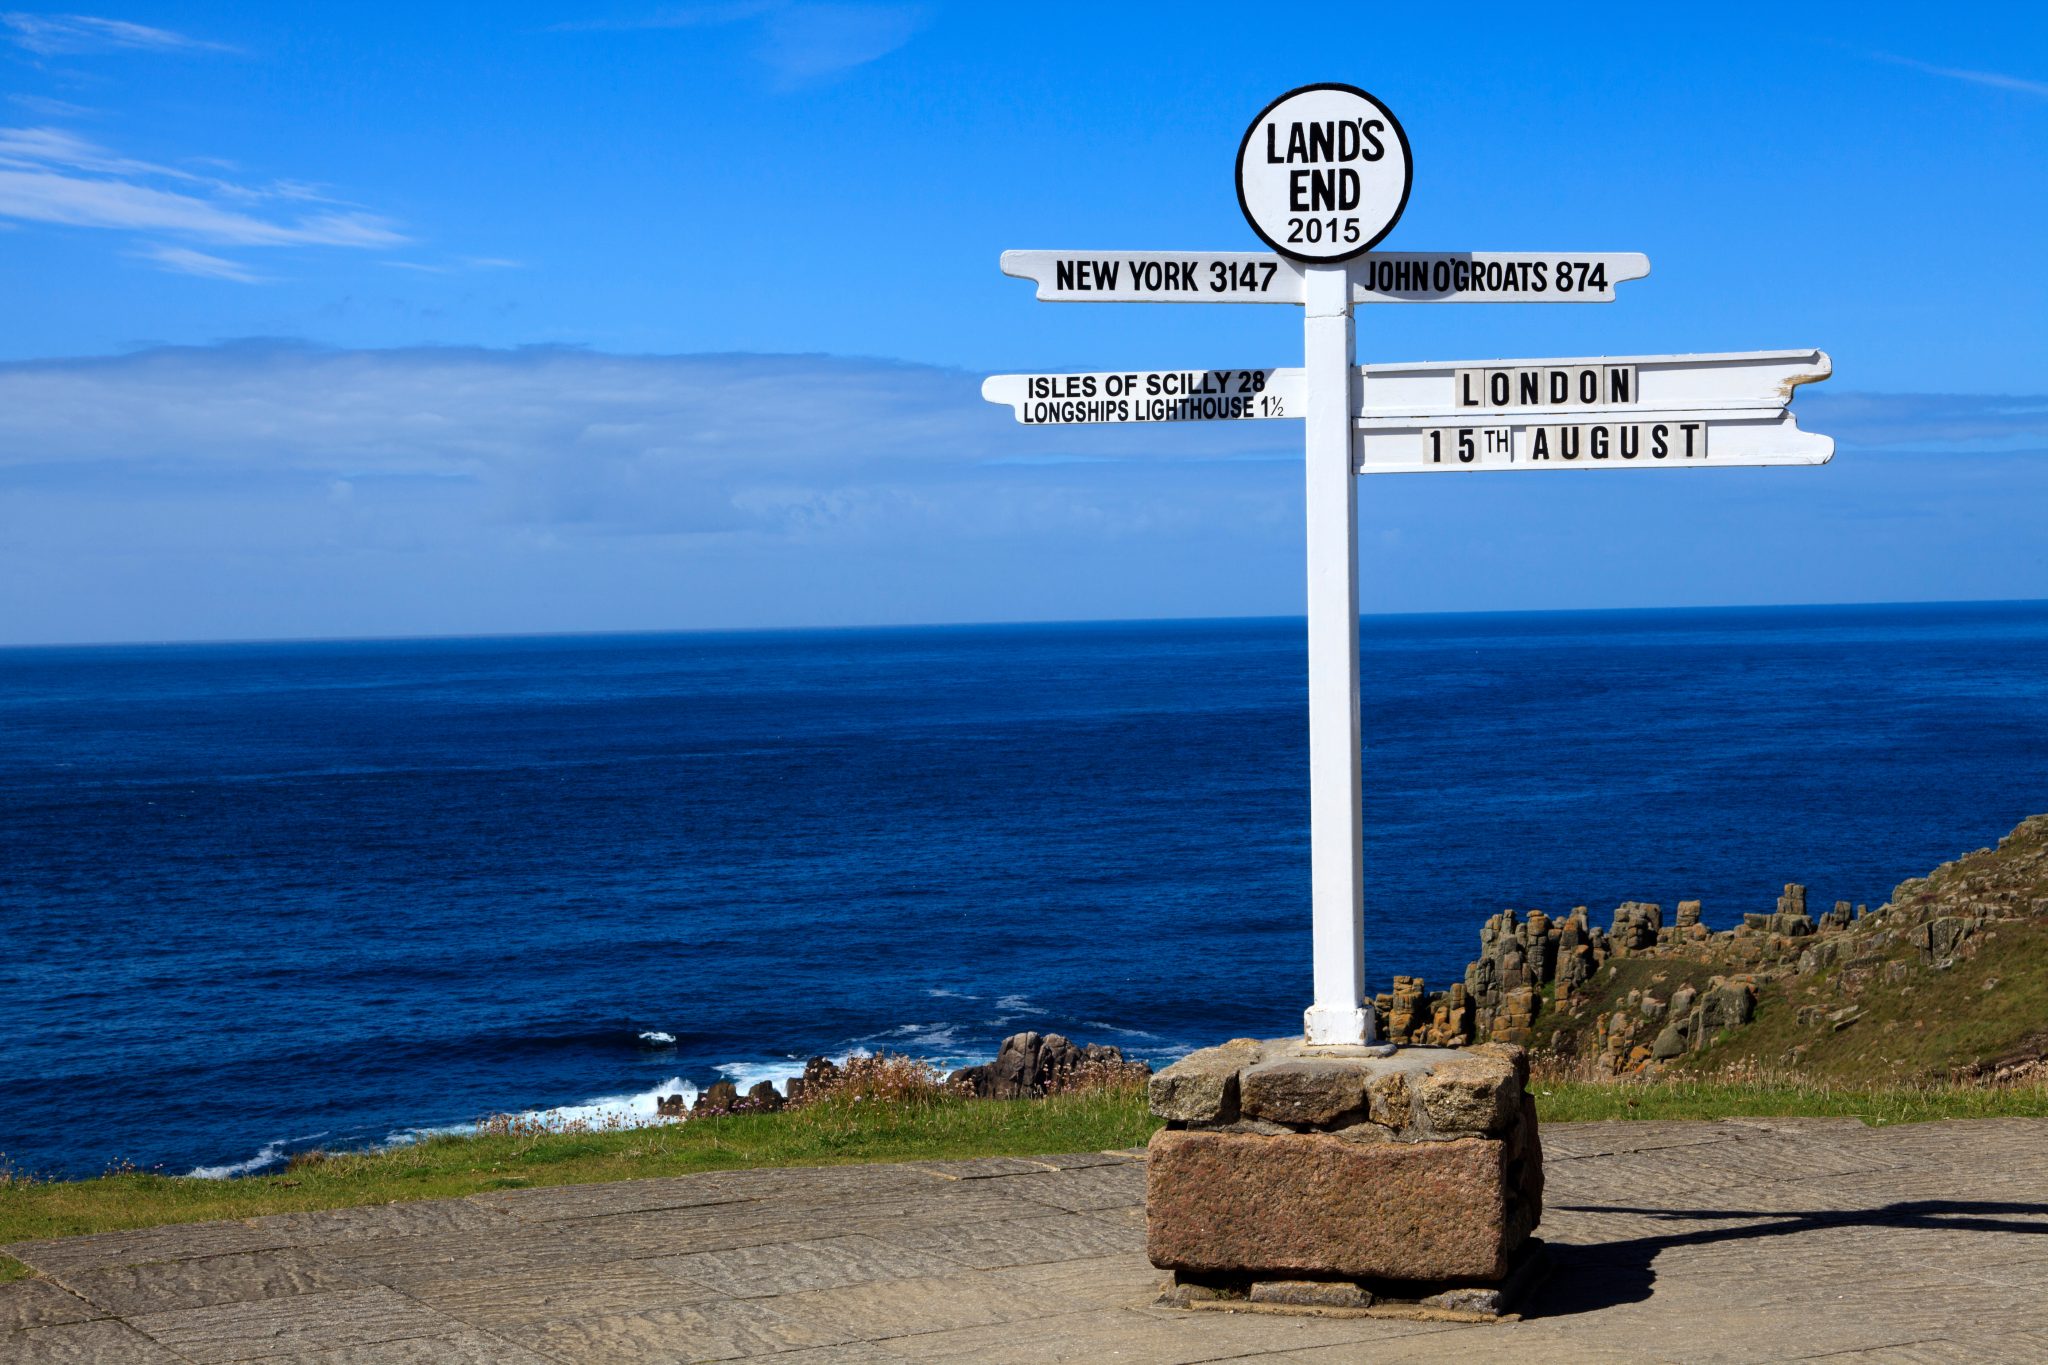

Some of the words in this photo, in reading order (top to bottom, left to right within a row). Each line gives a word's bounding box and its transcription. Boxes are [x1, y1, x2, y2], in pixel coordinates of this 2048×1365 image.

[1267, 117, 1385, 164] LAND'S
[1289, 168, 1361, 212] END
[1287, 217, 1361, 244] 2015
[1056, 260, 1120, 291] NEW
[1128, 261, 1199, 292] YORK
[1209, 261, 1278, 292] 3147
[1364, 260, 1429, 292] JOHN
[1433, 257, 1548, 292] O'GROATS
[1555, 261, 1608, 293] 874
[1028, 375, 1097, 399] ISLES
[1105, 374, 1138, 397] OF
[1146, 371, 1232, 396] SCILLY
[1238, 370, 1266, 393] 28
[1462, 367, 1630, 407] LONDON
[1023, 399, 1129, 423] LONGSHIPS
[1135, 396, 1254, 421] LIGHTHOUSE
[1532, 423, 1700, 460] AUGUST
